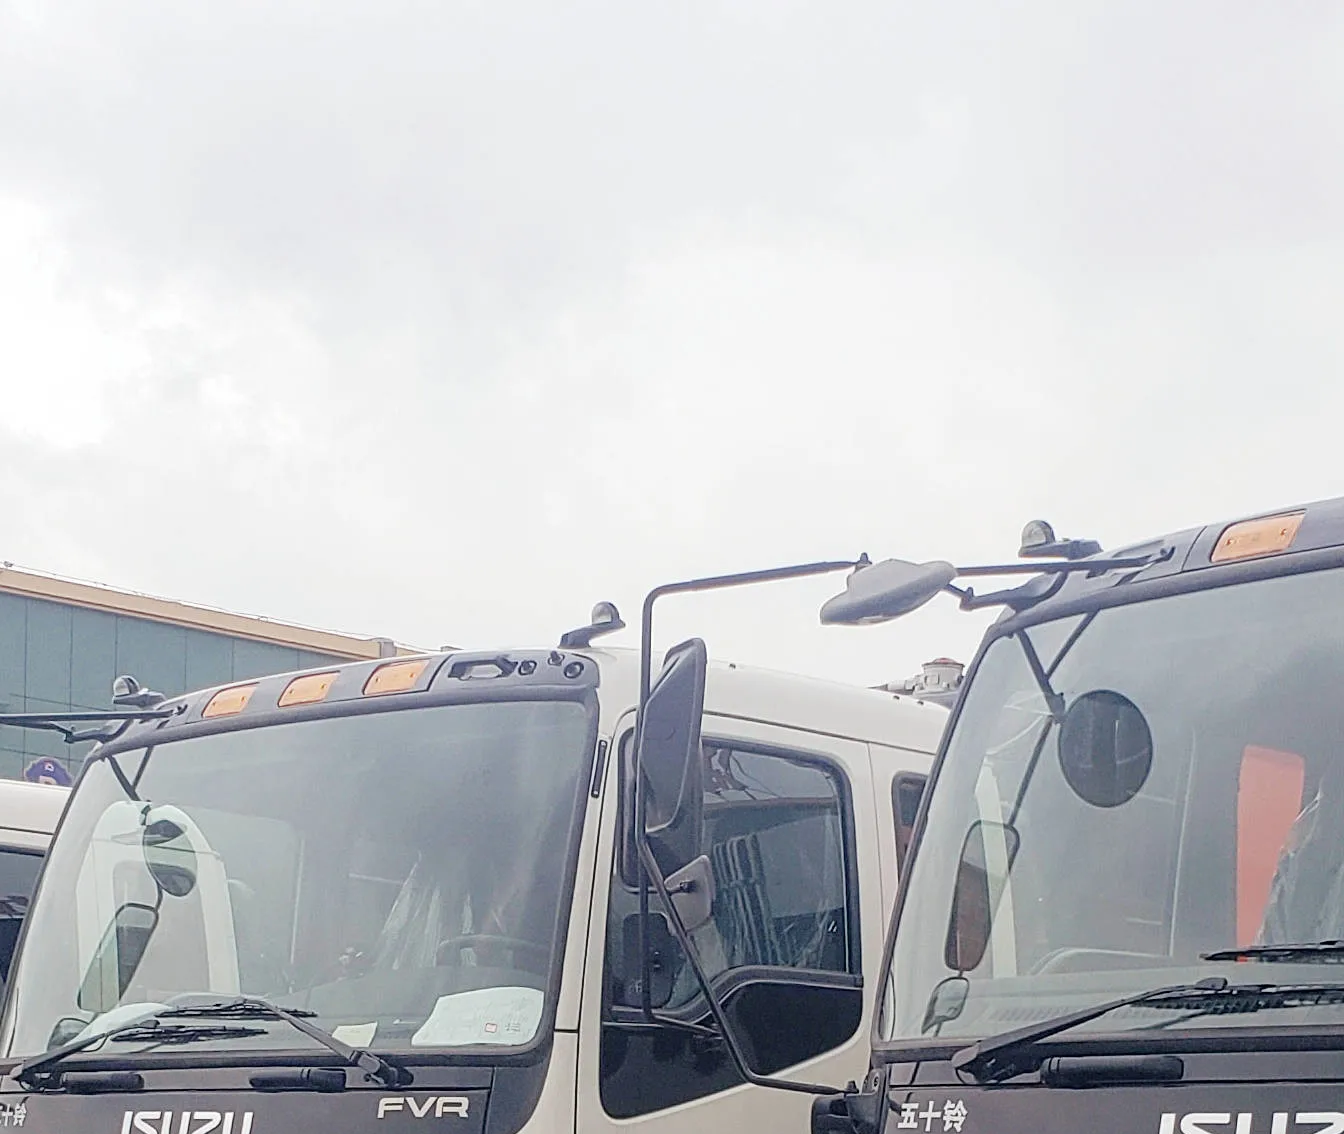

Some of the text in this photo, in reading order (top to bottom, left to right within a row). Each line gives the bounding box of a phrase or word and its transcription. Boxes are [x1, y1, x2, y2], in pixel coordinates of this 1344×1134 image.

[377, 1096, 469, 1119] FVR
[897, 1099, 968, 1132] 五十铃
